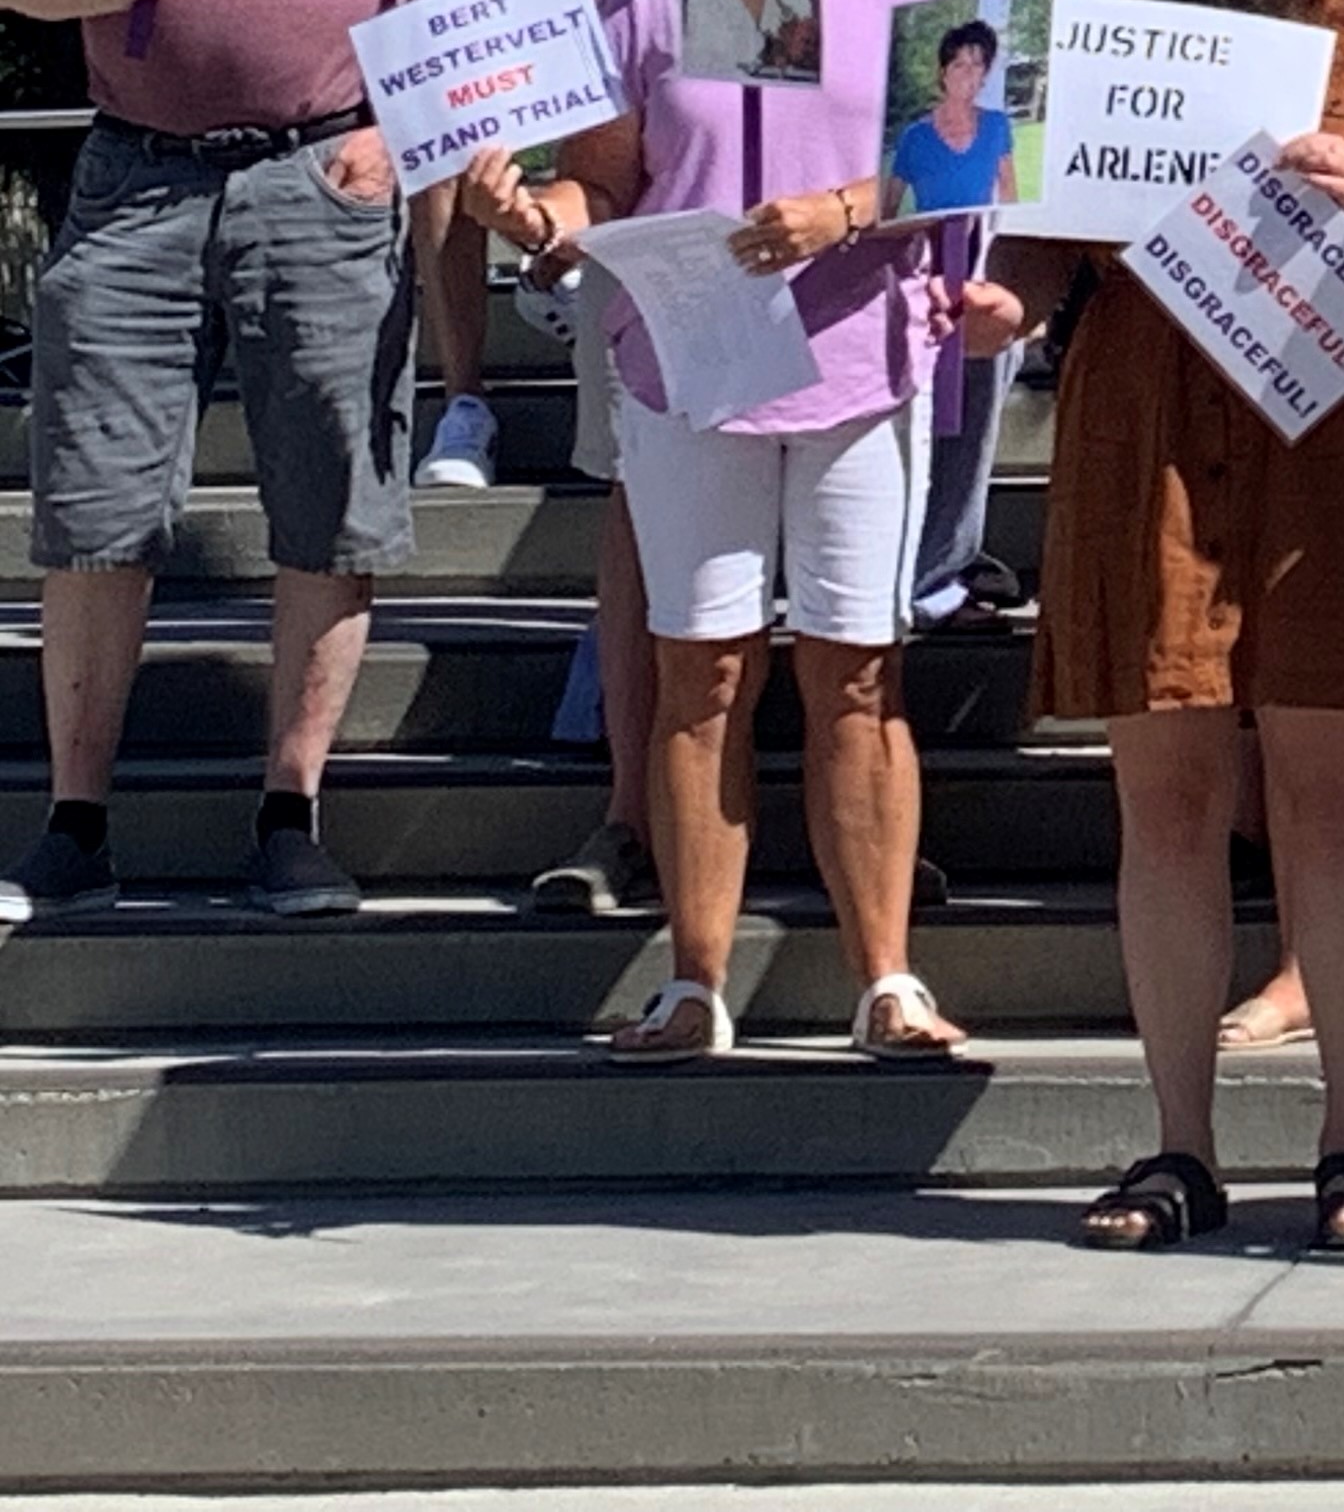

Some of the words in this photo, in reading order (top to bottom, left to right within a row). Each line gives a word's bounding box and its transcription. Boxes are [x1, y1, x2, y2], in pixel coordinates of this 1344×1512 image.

[379, 6, 585, 96] WESTERVELT
[1055, 20, 1233, 66] JUSTICE
[447, 63, 536, 109] MUST
[1106, 84, 1186, 121] FOR
[400, 117, 500, 172] STAND
[1145, 233, 1319, 419] DISGRACEFUL!
